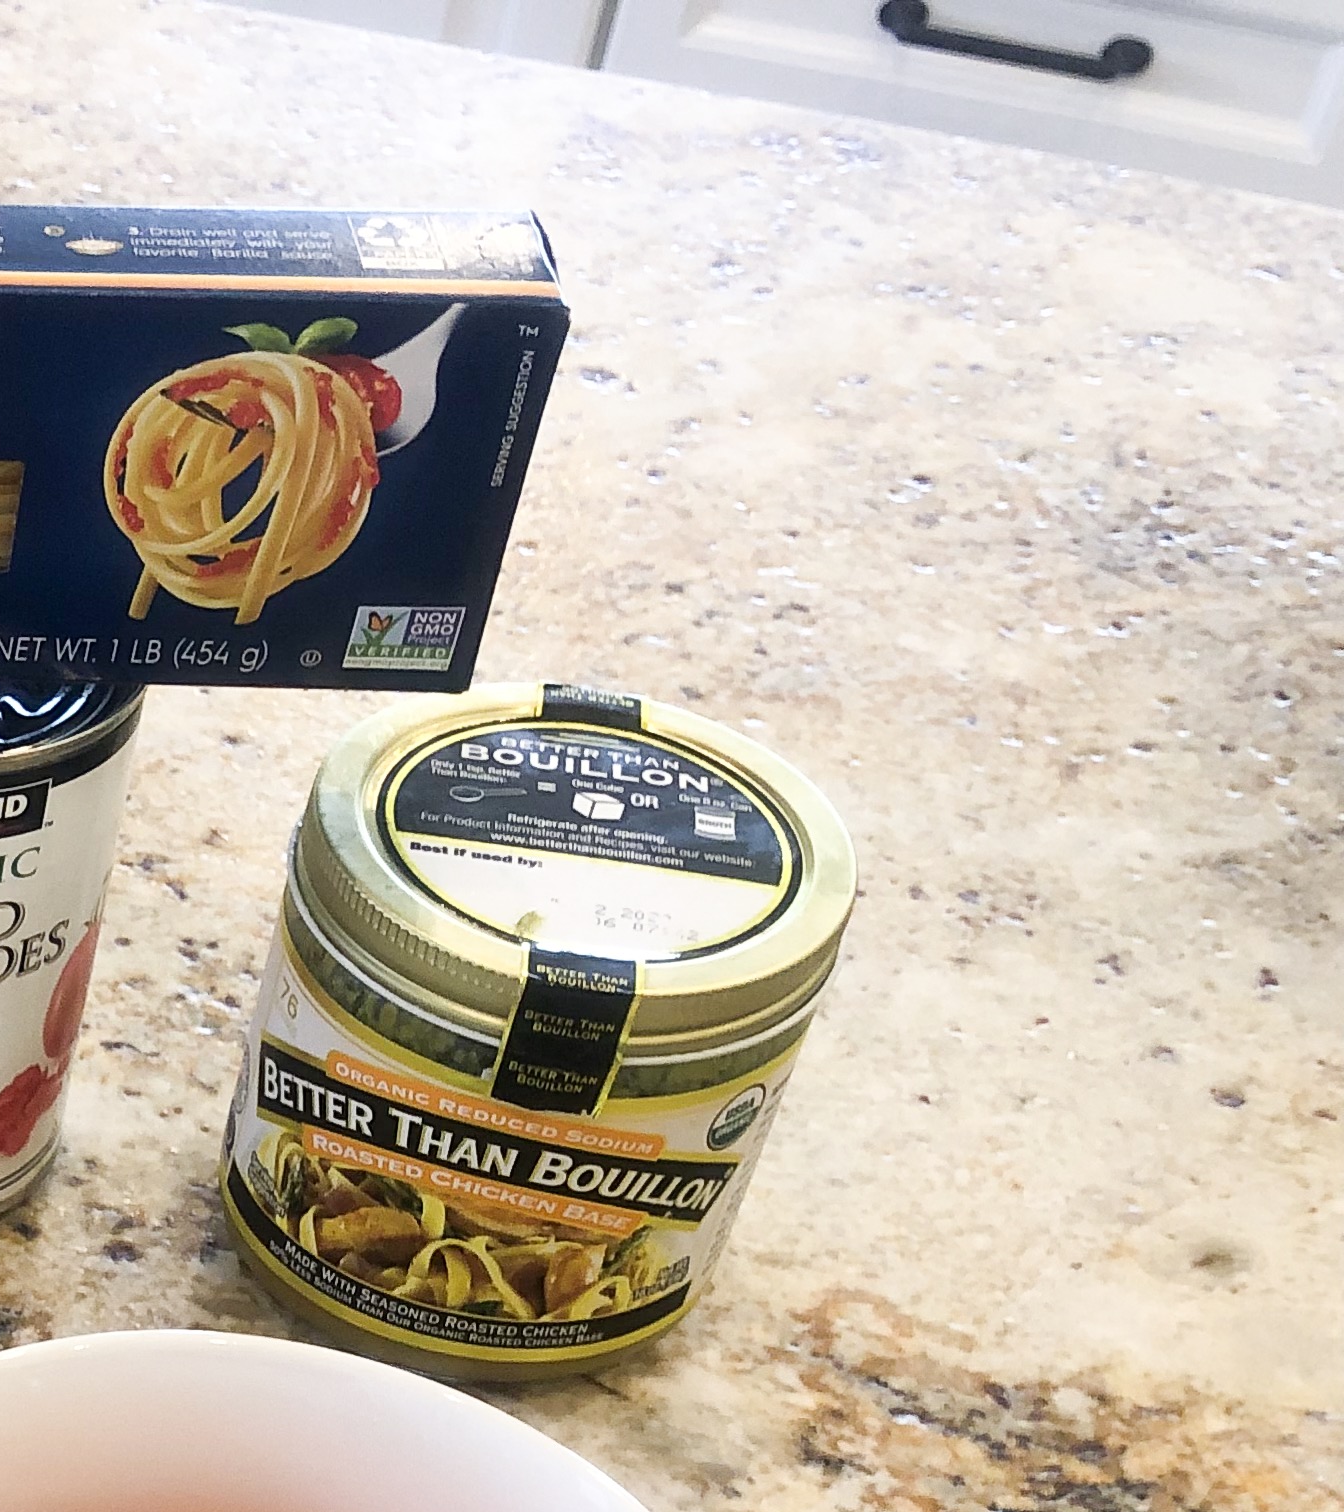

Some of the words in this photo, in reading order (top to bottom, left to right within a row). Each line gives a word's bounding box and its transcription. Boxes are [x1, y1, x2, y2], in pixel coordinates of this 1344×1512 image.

[243, 228, 278, 239] and
[247, 238, 283, 249] with
[505, 350, 535, 431] SUGGESTION
[410, 623, 454, 636] GMO
[414, 611, 458, 624] NON
[55, 637, 97, 663] WT.
[110, 638, 119, 663] 1
[130, 638, 161, 664] LB
[173, 637, 230, 670] (454
[240, 640, 270, 673] g)
[354, 646, 447, 658] VERIFIED
[501, 736, 600, 760] BETTER
[608, 750, 680, 771] THAN
[461, 743, 709, 793] BOUILLON
[630, 793, 660, 810] OR
[420, 811, 440, 823] For
[444, 814, 491, 830] Product
[494, 820, 565, 840] Information
[568, 831, 592, 843] and
[507, 812, 578, 832] Refrigerate
[581, 822, 611, 836] after
[410, 842, 448, 855] Best
[471, 851, 513, 864] used
[490, 832, 684, 868] www.betterthanbouillon.com
[536, 964, 587, 979] BETTER
[591, 972, 629, 987] THAN
[547, 973, 617, 994] BOUILLON
[524, 1009, 575, 1026] BETTER
[580, 1018, 615, 1033] THAN
[532, 1022, 601, 1041] BOUILLON
[508, 1060, 558, 1080] BETTER
[563, 1071, 598, 1086] THAN
[516, 1075, 583, 1094] BOUILLON
[335, 1061, 431, 1106] ORGANIC
[438, 1098, 558, 1138] REDUCED
[564, 1129, 654, 1155] SODIUM
[263, 1056, 374, 1137] BETTER
[388, 1107, 518, 1178] THAN
[528, 1150, 722, 1211] BOUILLON
[312, 1133, 424, 1179] ROASTED
[430, 1169, 557, 1215] CHICKEN
[562, 1204, 635, 1230] BASE
[284, 1240, 317, 1275] MADE
[321, 1266, 357, 1296] WITH
[360, 1288, 440, 1326] SEASONED
[444, 1316, 518, 1337] ROASTED
[522, 1323, 589, 1337] CHICKEN
[313, 1277, 352, 1305] SODIUM
[355, 1299, 384, 1318] THAN
[386, 1312, 410, 1328] OUR
[413, 1321, 466, 1342] ORGANIC
[468, 1333, 522, 1347] ROASTED
[525, 1336, 573, 1347] CHICKEN
